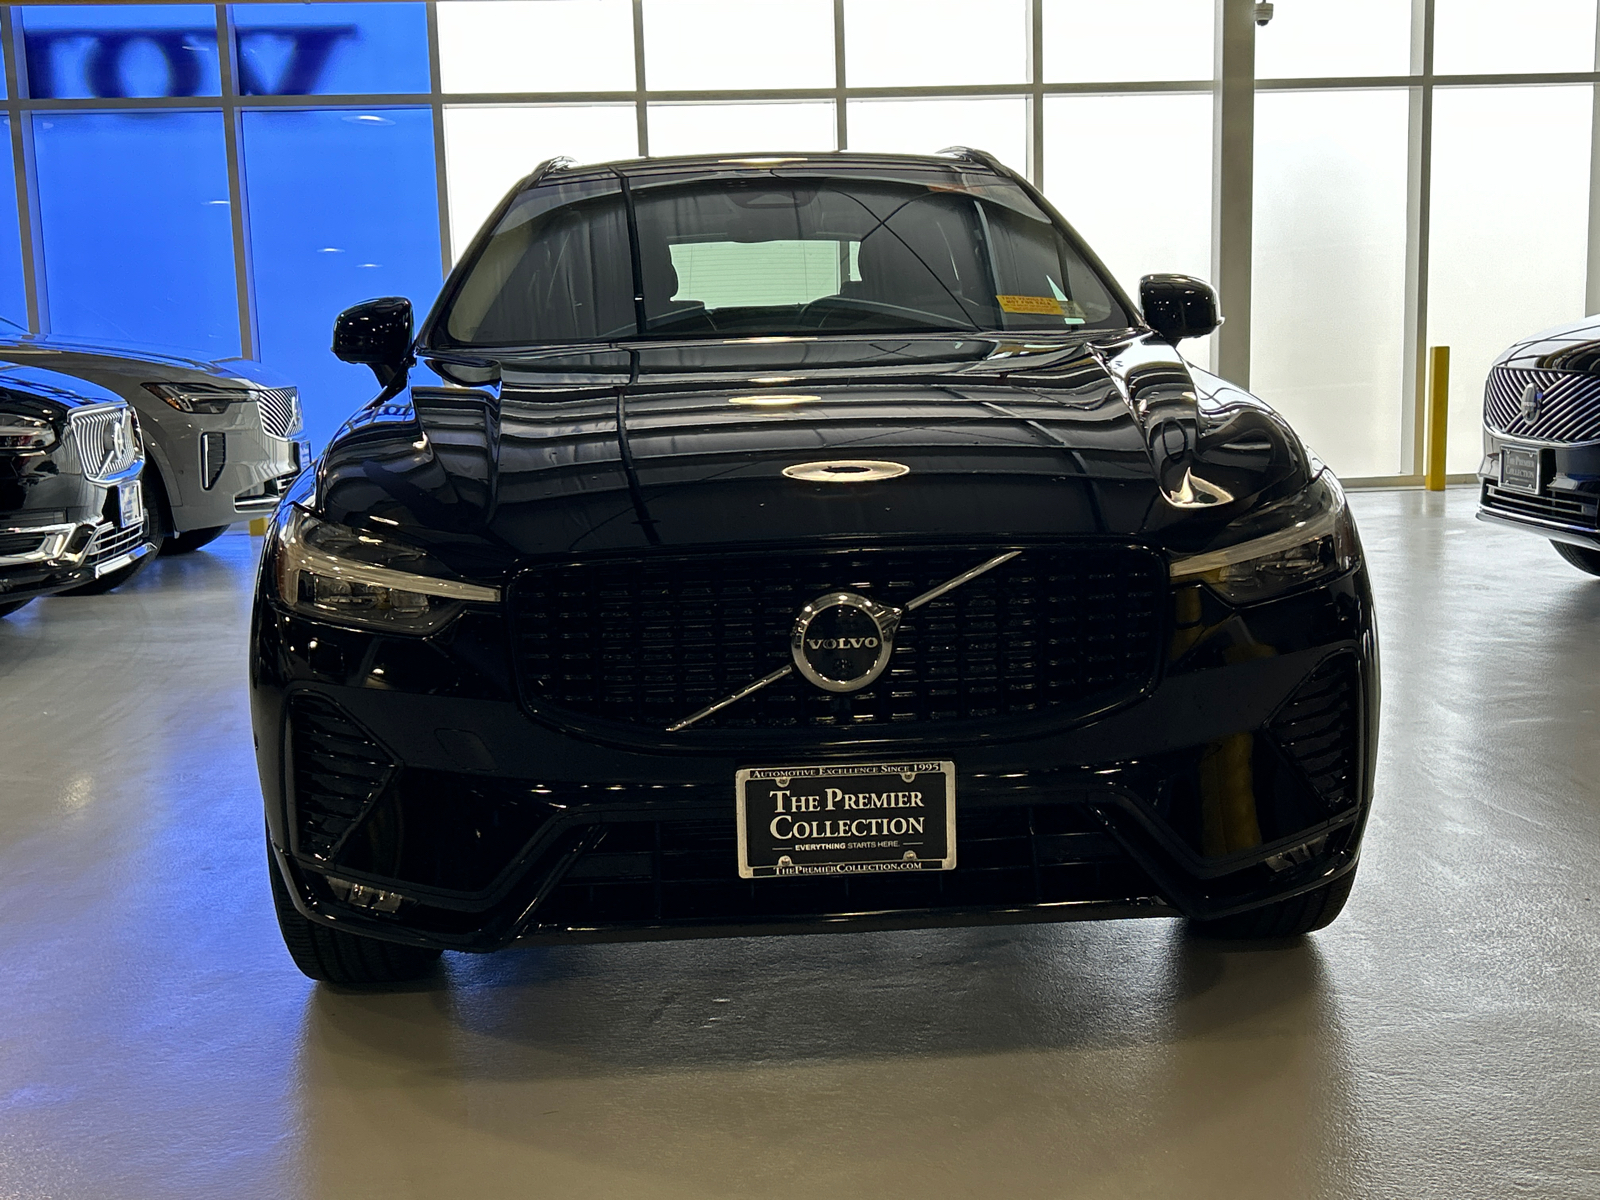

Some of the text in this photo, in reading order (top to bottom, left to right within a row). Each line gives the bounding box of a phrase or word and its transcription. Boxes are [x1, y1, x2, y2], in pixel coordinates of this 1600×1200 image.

[806, 637, 878, 650] VOLVO
[753, 763, 940, 778] AUTOMOTIVE EXCELLENCE SINCE 1995
[770, 788, 924, 813] THE PREMIER
[769, 814, 925, 840] COLLECTION
[795, 842, 846, 851] EVERYTHING
[847, 841, 877, 849] STARTS
